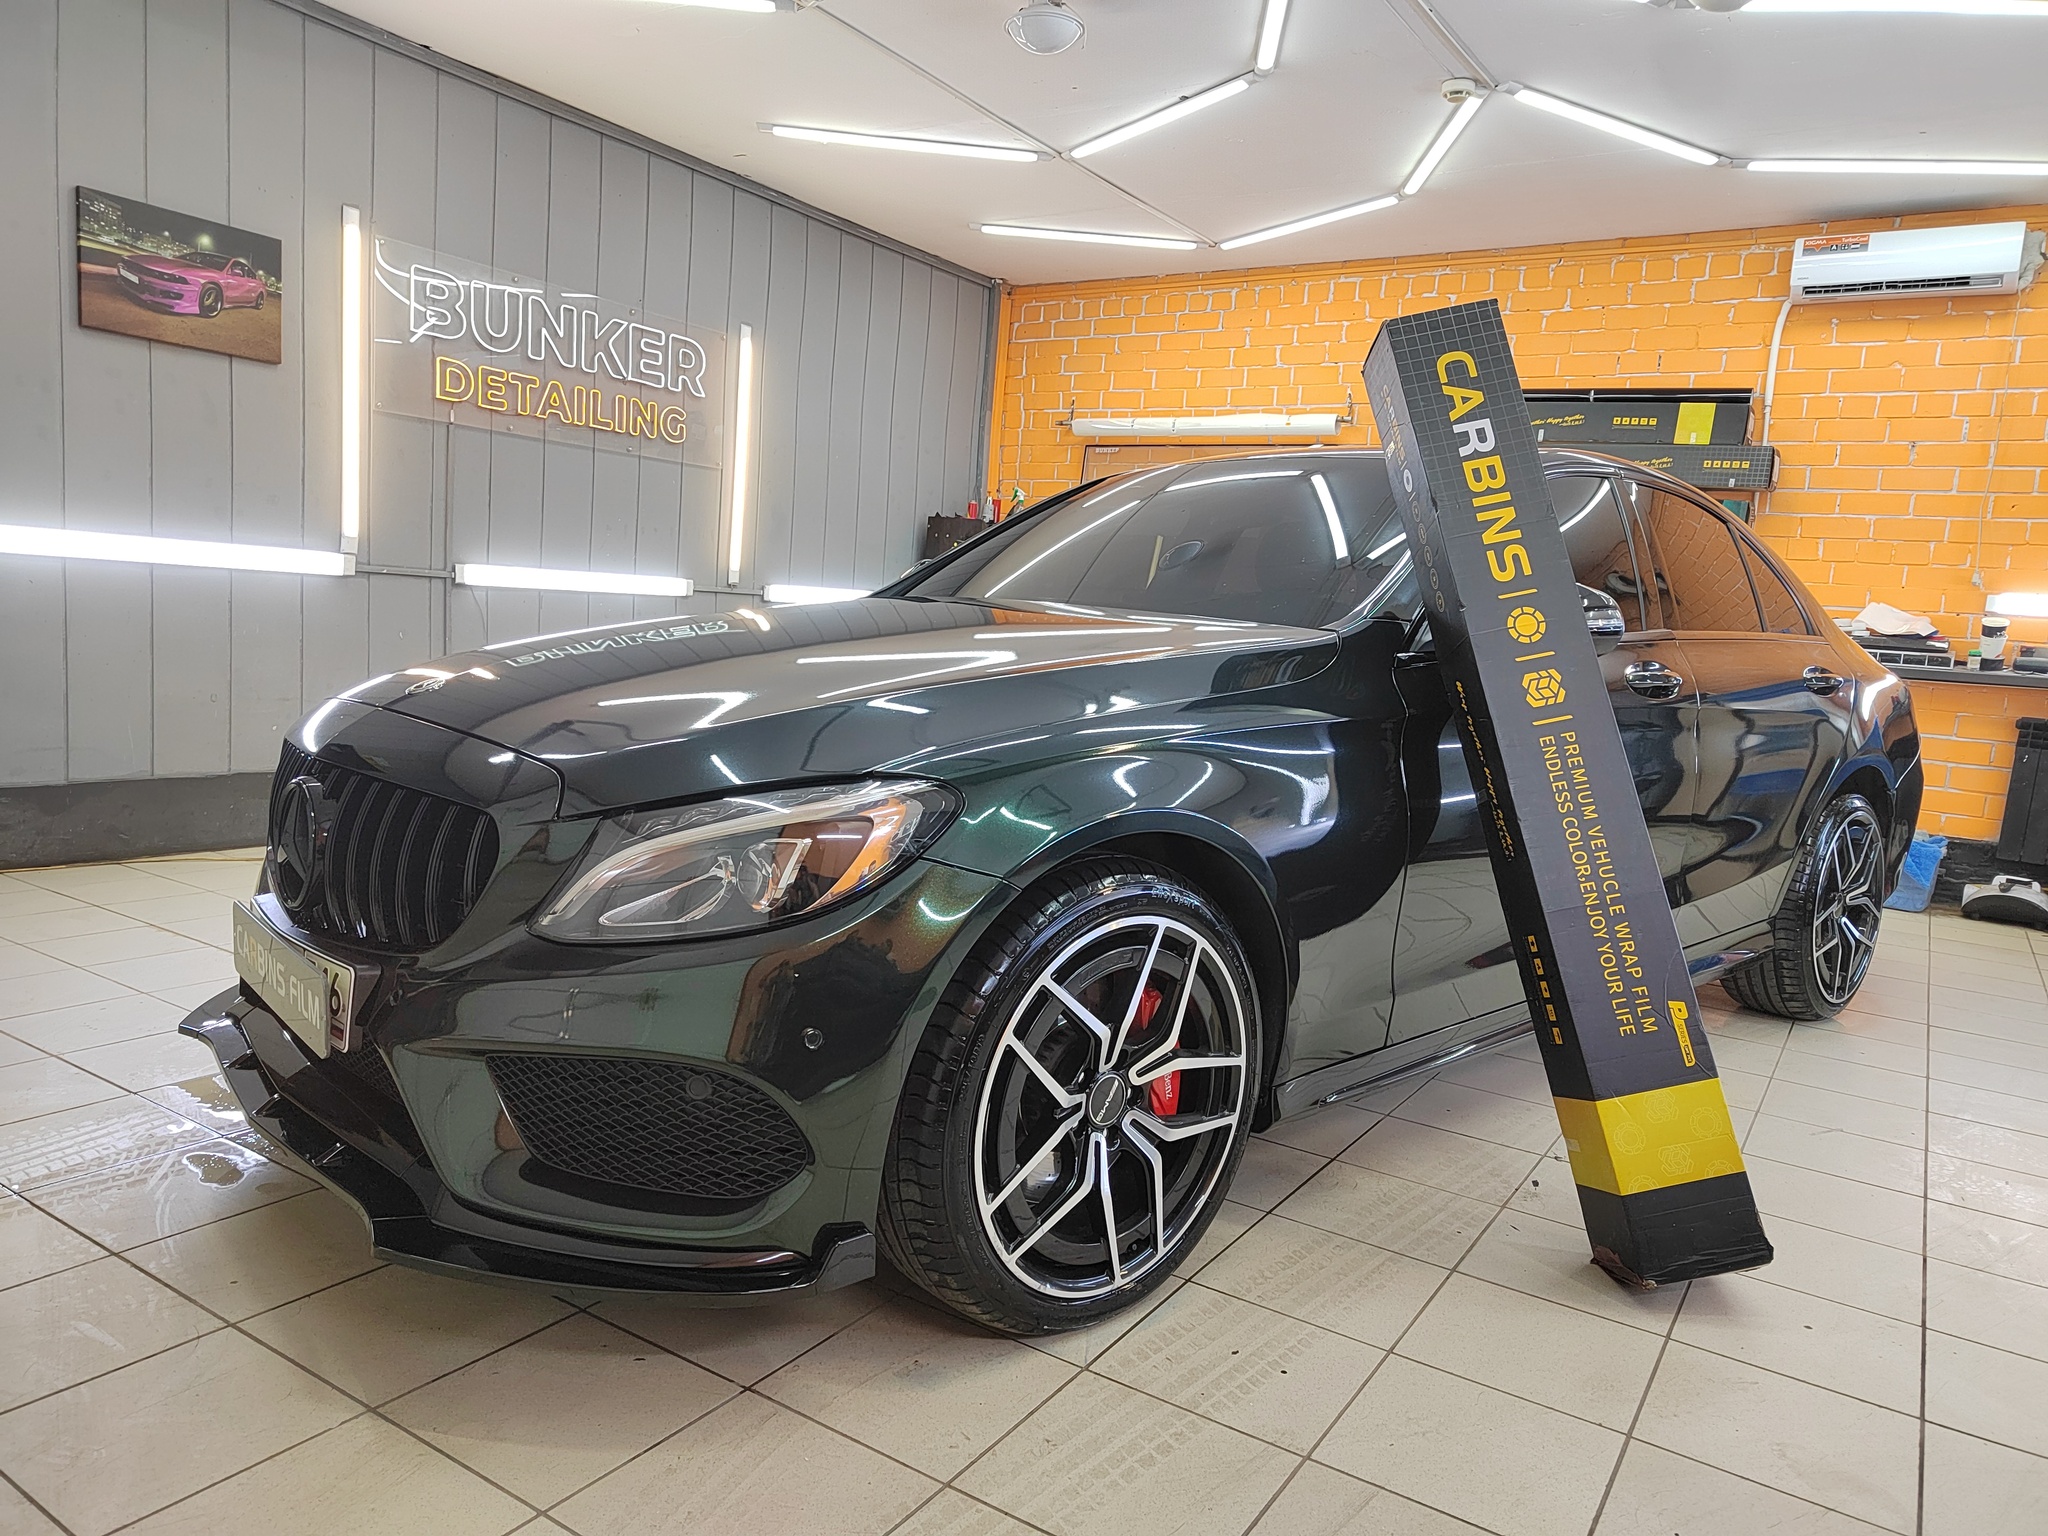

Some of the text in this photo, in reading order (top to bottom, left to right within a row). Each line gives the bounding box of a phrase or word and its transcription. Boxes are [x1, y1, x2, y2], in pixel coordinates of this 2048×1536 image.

[409, 264, 706, 398] BUNKER
[435, 356, 687, 444] DETAILING
[1436, 350, 1533, 583] CARBINS
[1539, 735, 1574, 814] ENDLESS
[1597, 942, 1624, 995] YOUR
[1611, 996, 1637, 1038] LIFE
[1560, 731, 1658, 1034] PREMIUM VEHUCLE WRAP FILM
[236, 924, 286, 998] CARBINS
[289, 974, 320, 1030] FILM
[1677, 1023, 1688, 1044] SERIES
